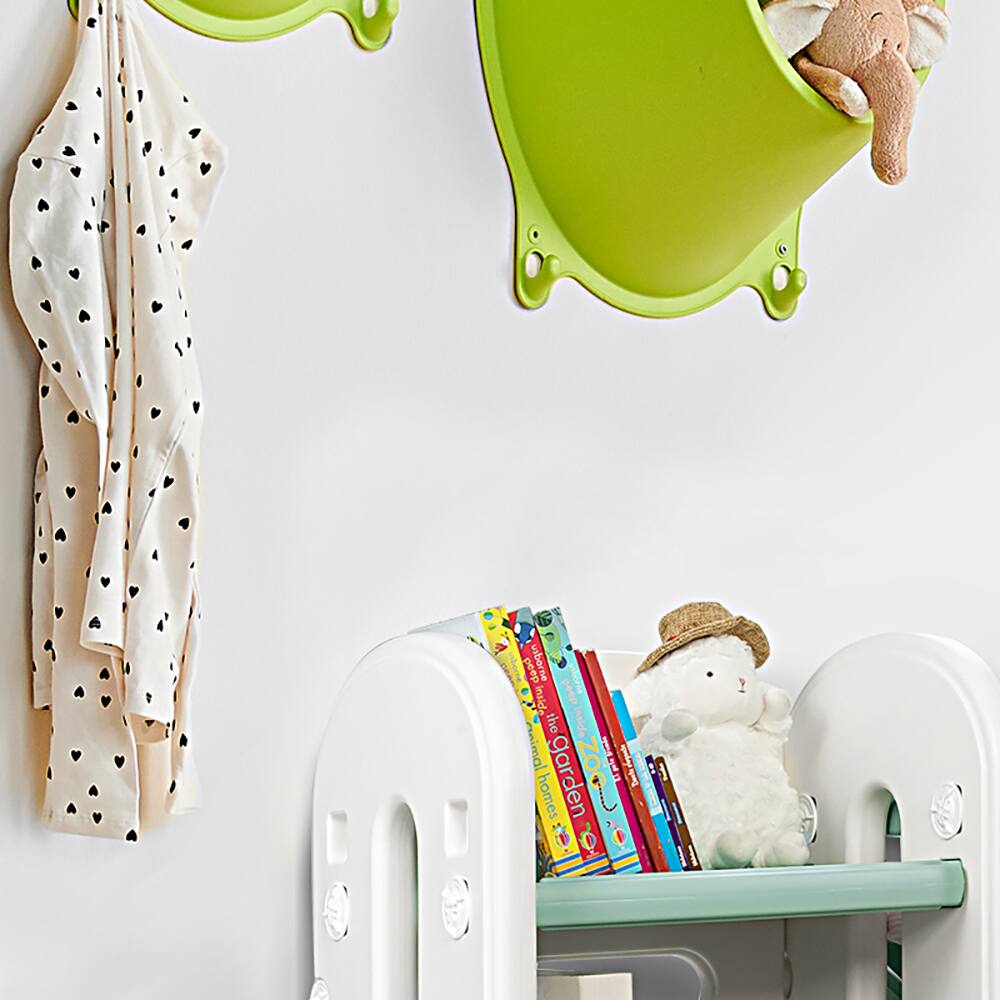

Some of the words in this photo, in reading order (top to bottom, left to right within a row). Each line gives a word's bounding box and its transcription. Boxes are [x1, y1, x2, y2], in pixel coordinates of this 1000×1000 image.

[523, 657, 539, 683] peep
[531, 644, 548, 682] usborne
[546, 713, 559, 734] the
[548, 735, 586, 818] garden
[538, 772, 559, 820] homes
